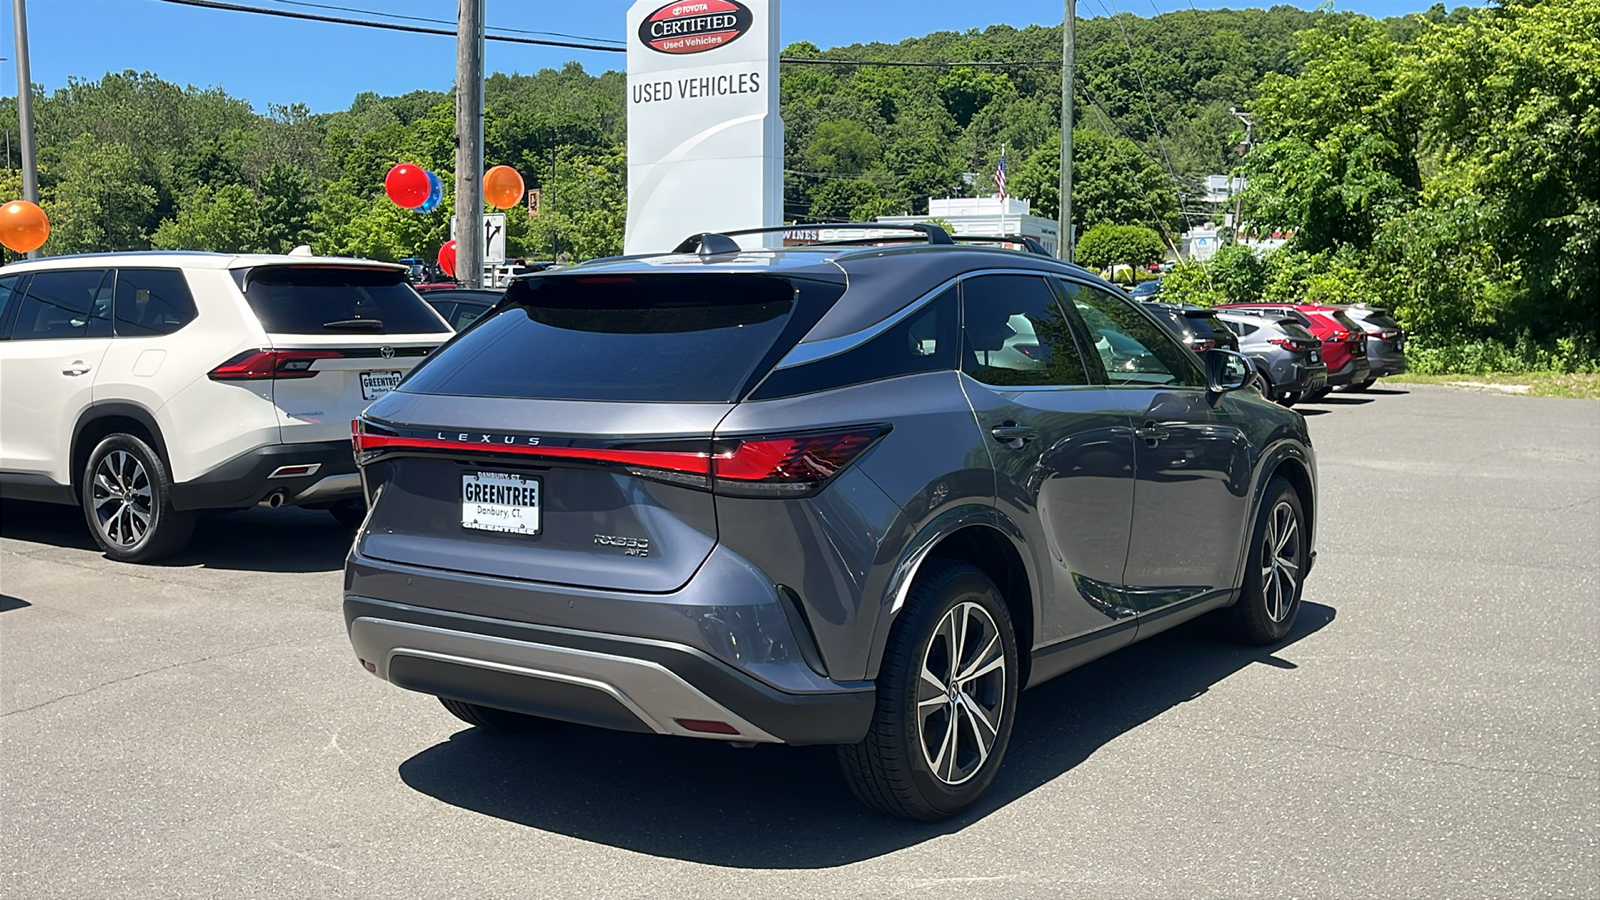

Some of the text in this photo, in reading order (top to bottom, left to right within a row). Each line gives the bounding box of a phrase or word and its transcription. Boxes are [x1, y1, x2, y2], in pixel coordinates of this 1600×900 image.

[682, 3, 708, 14] TOYOTA
[651, 14, 737, 38] CERTIFIED
[663, 36, 722, 50] Used Vehicles
[633, 72, 760, 104] USED VEHICLES
[783, 230, 817, 240] WINES
[437, 432, 540, 446] LEXUS
[465, 482, 536, 507] GREENTREE
[477, 505, 523, 520] Danbury, CT.
